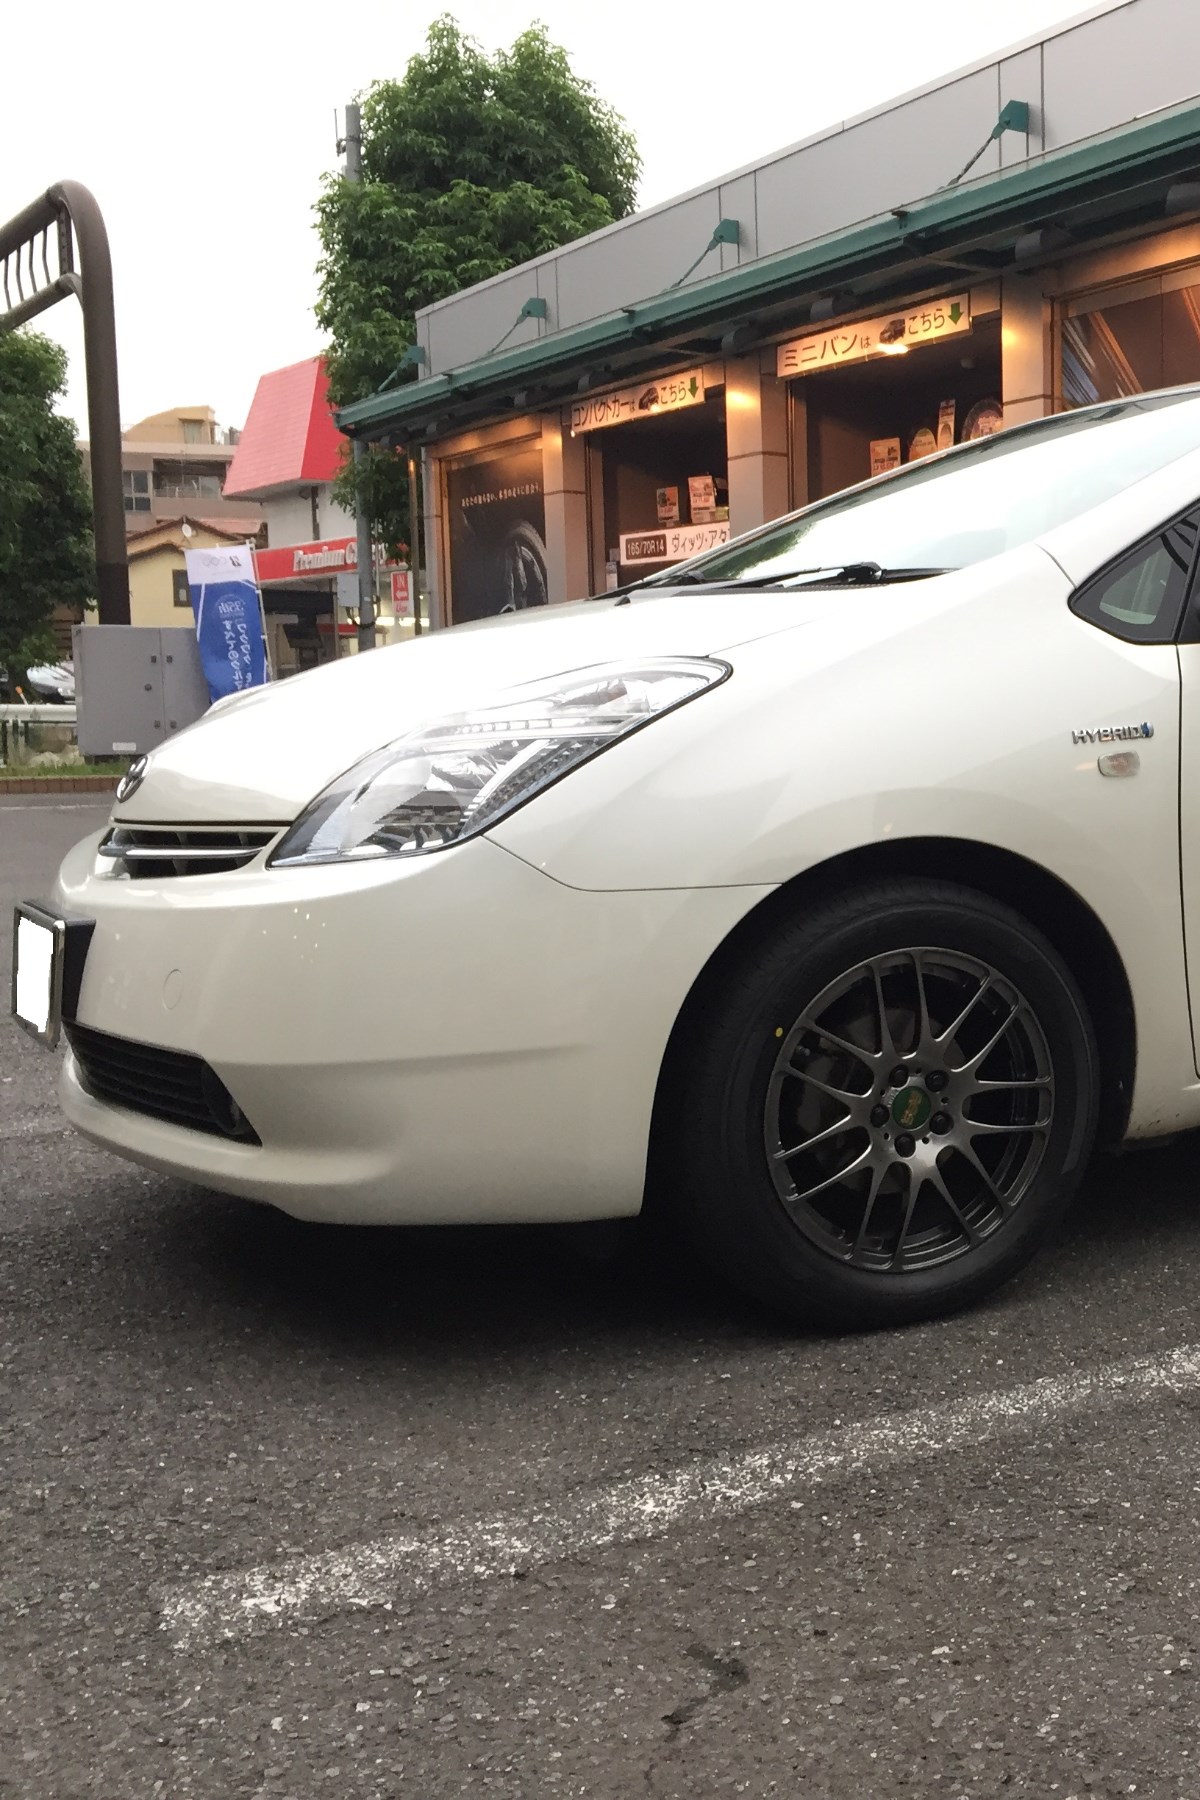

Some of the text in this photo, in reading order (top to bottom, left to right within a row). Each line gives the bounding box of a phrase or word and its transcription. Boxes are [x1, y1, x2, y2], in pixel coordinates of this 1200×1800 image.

[784, 308, 945, 368] ミニバンは こちら
[573, 381, 687, 427] コンパクトカーは こちら
[627, 528, 730, 556] 165/70R14 ヴィッツ・アク
[293, 546, 345, 572] Premium
[1072, 726, 1140, 744] HYBRID
